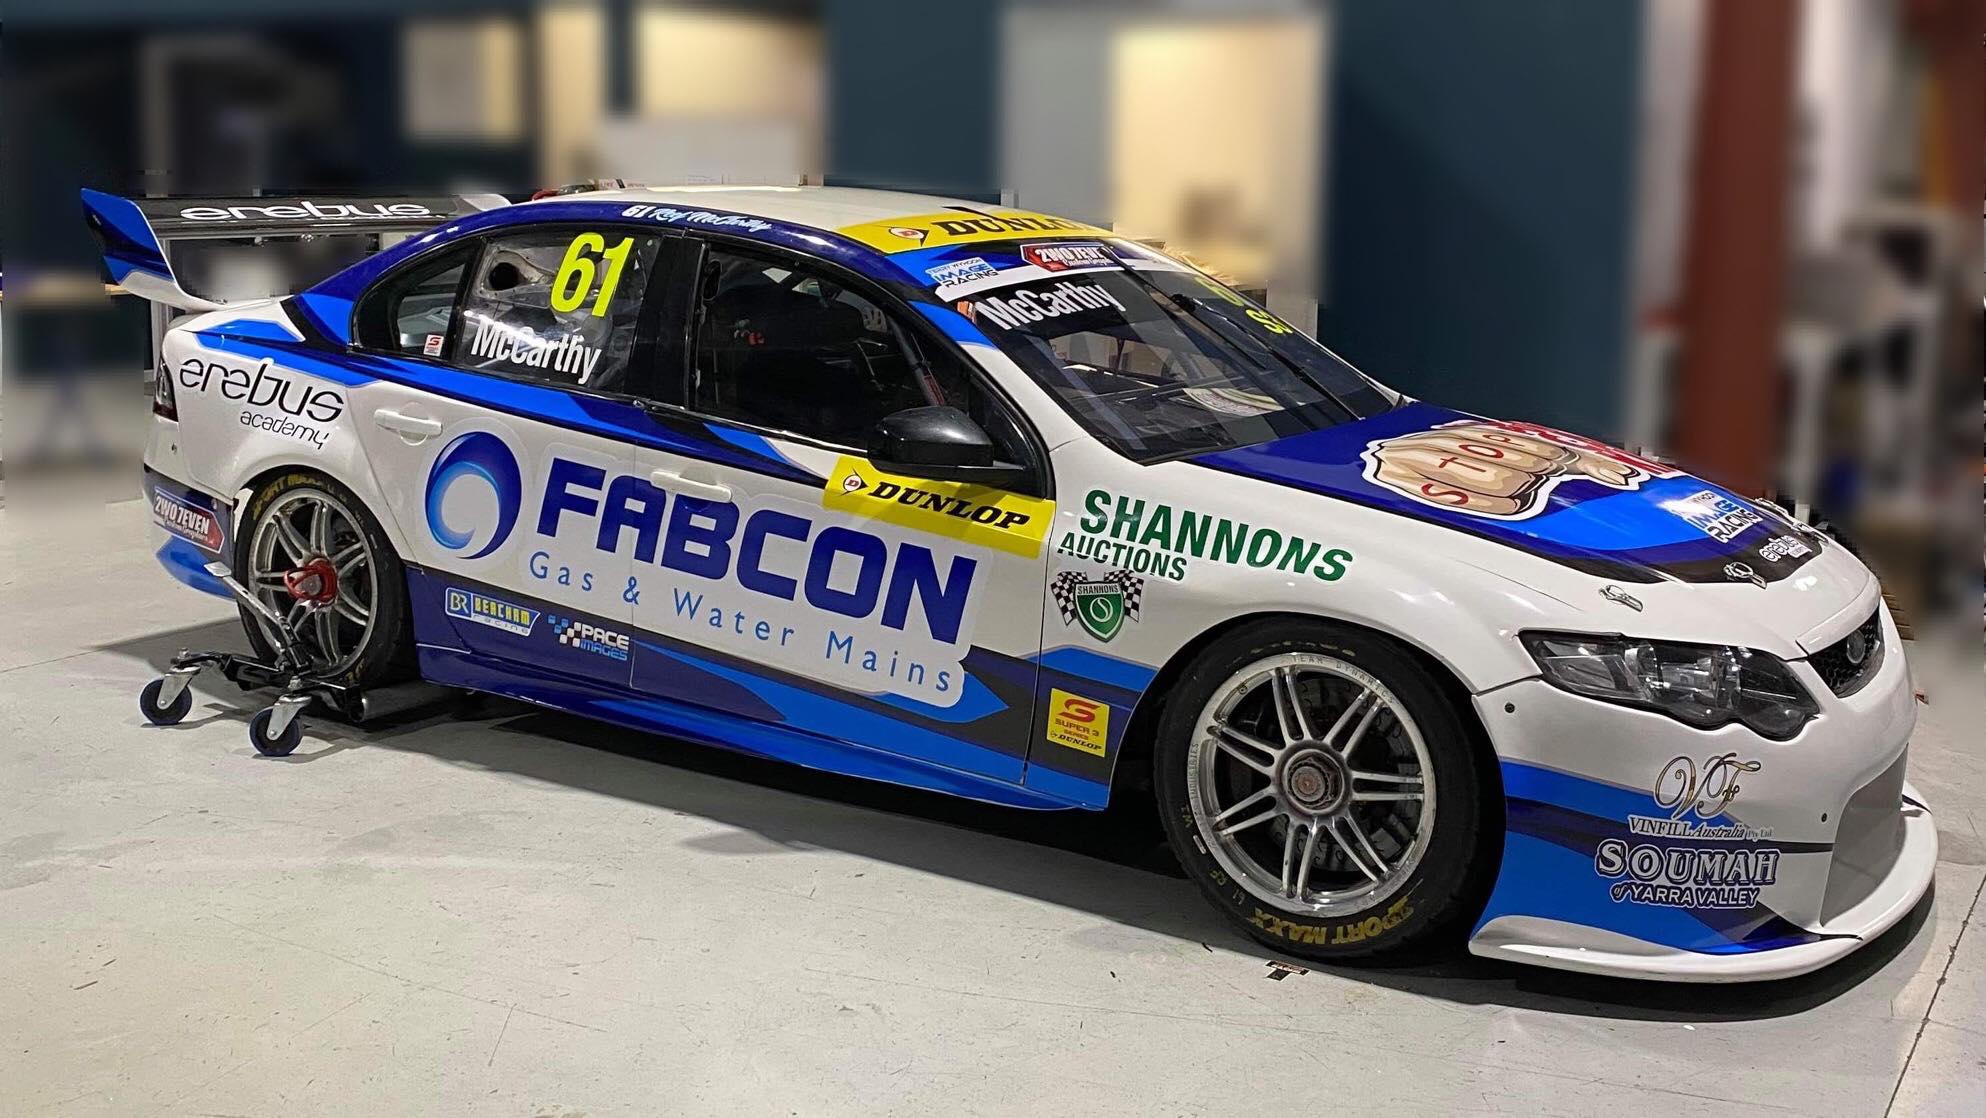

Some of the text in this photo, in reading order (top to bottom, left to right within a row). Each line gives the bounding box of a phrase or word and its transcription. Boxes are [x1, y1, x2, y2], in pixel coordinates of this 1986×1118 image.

[180, 201, 431, 221] erebus
[622, 205, 648, 218] 61
[550, 232, 635, 317] 61
[934, 263, 990, 281] IMAGE
[943, 269, 998, 287] RACING
[974, 281, 1126, 330] McCarthy
[470, 321, 601, 385] McCarthy
[180, 358, 344, 423] erebus
[240, 411, 329, 450] academy
[868, 481, 1030, 529] DUNLOP
[1080, 489, 1353, 582] SHANNONS
[1707, 508, 1759, 539] RACING
[537, 458, 977, 645] FABCON
[1057, 532, 1187, 581] AUCTIONS
[450, 592, 469, 614] BR
[1077, 584, 1119, 596] SHANNONS
[474, 597, 530, 626] BEACHAM
[528, 550, 951, 693] Gas & Water Mains
[579, 638, 628, 661] IMAGES
[580, 624, 630, 650] PACE
[1055, 717, 1100, 737] SUPER 3
[1058, 734, 1102, 751] DUNLOP
[1630, 817, 1692, 838] VINFILL
[1691, 822, 1745, 839] Australia
[1599, 841, 1778, 886] SOUMAH
[1614, 883, 1760, 905] of YARRA VALLEY
[1331, 896, 1415, 945] SPORT
